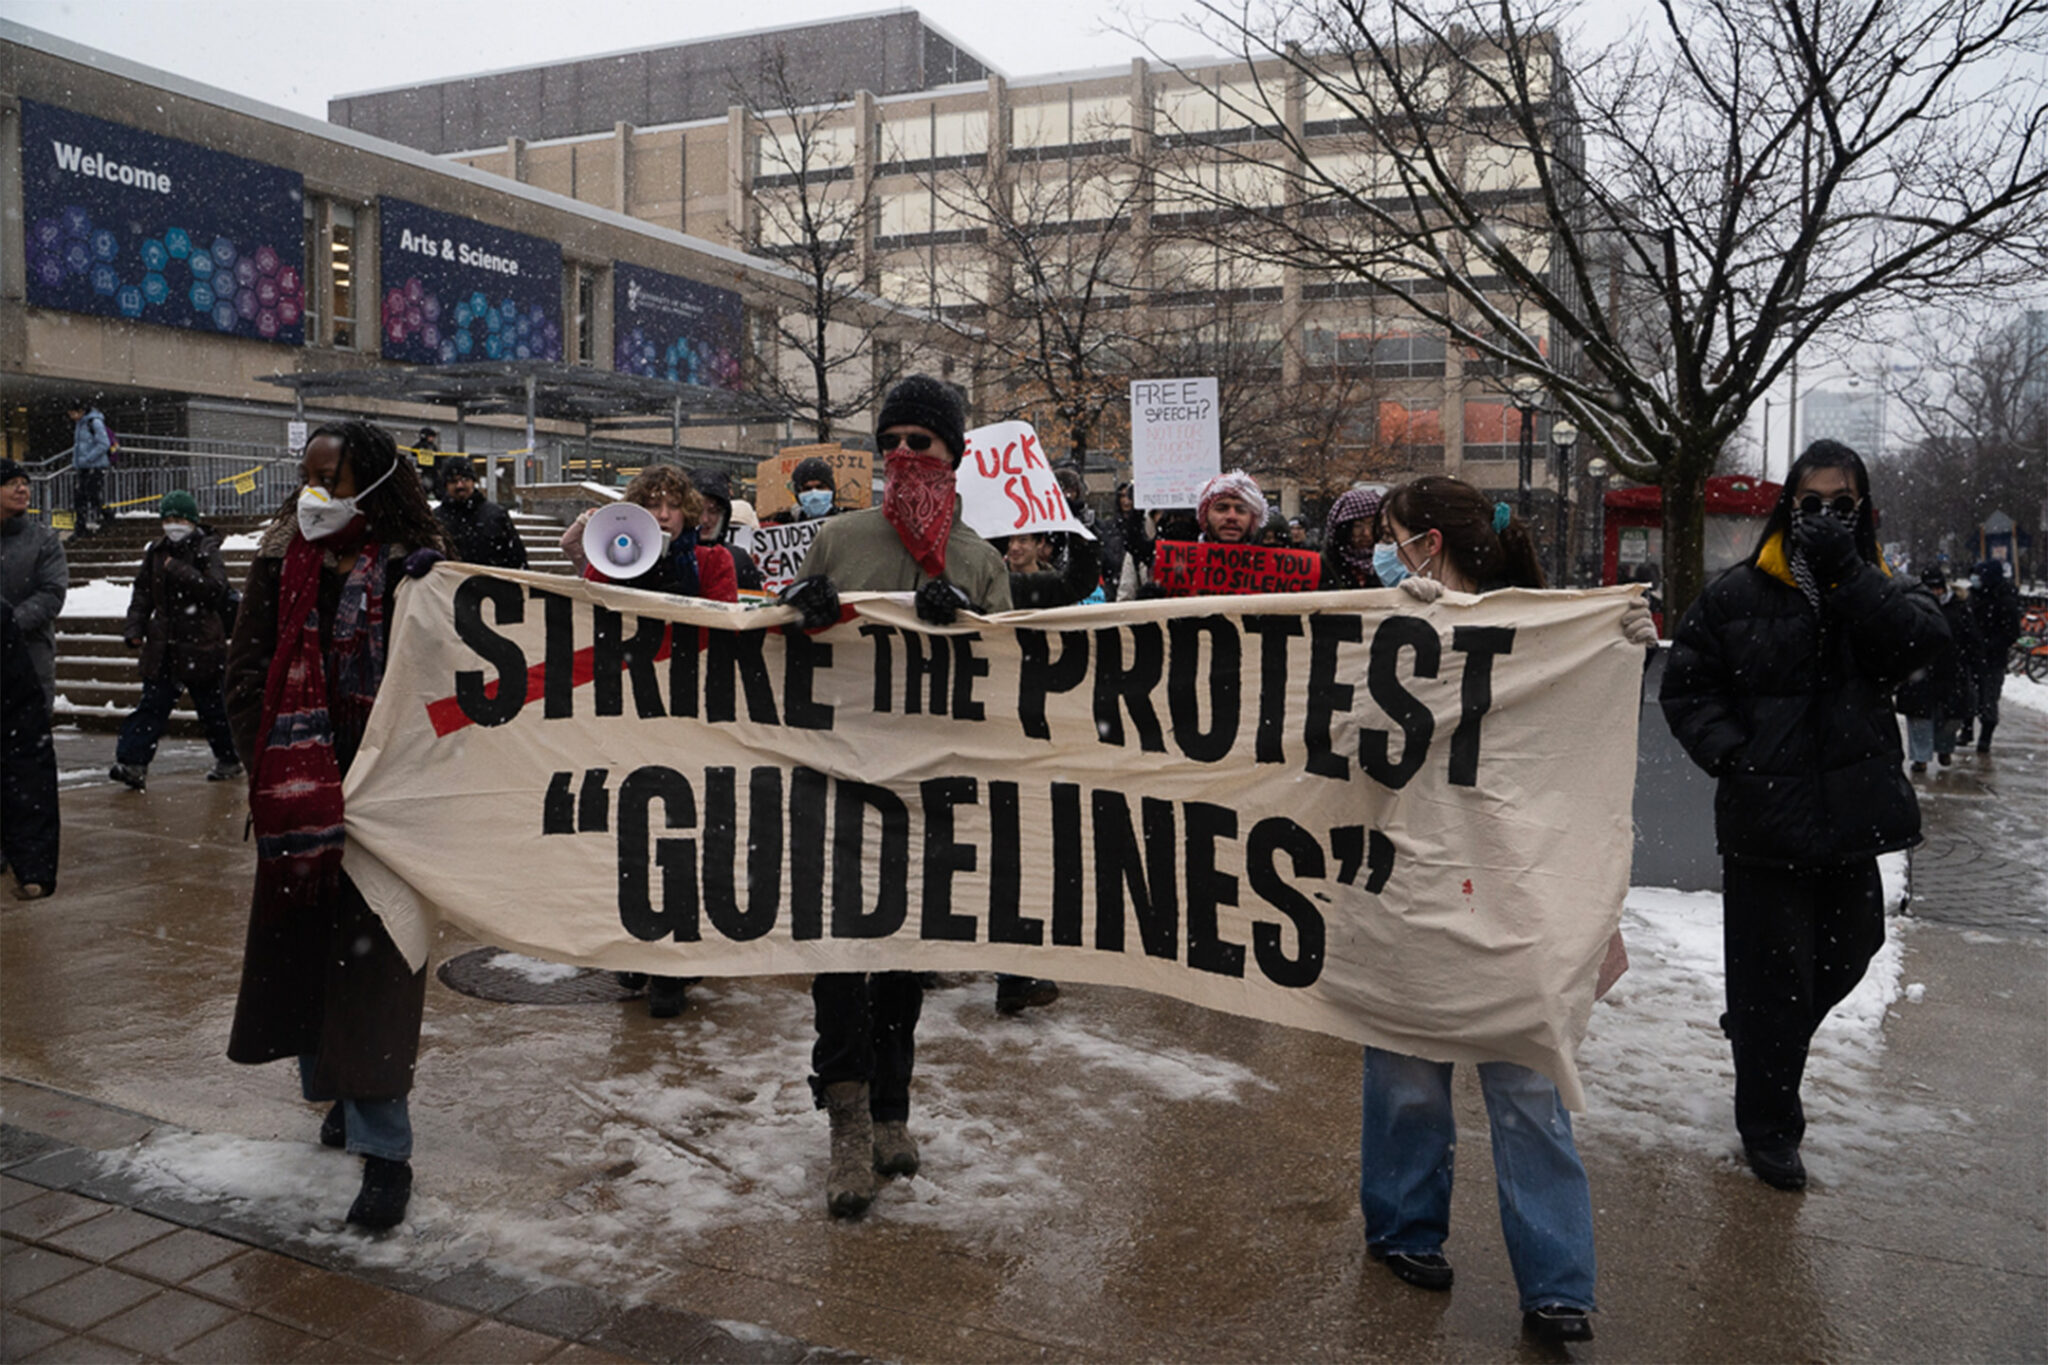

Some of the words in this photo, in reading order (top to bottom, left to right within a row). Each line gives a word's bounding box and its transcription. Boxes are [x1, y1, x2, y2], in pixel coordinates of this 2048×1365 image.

[53, 140, 172, 194] Welcome
[400, 228, 438, 257] Arts
[441, 238, 456, 261] &
[458, 243, 519, 276] Science
[1135, 382, 1199, 406] FREE
[1144, 398, 1211, 423] SPEECH?
[1003, 475, 1067, 529] Shit
[1160, 566, 1198, 586] TRY
[1203, 567, 1227, 587] TO
[1228, 571, 1312, 593] SILENCE
[1161, 545, 1198, 564] THE
[1206, 547, 1267, 571] MORE
[1273, 552, 1313, 575] YOU
[453, 576, 835, 730] STRIKE
[856, 623, 991, 722] THE
[1014, 610, 1517, 789] PROTEST
[542, 765, 1396, 989] “GUIDELINES”
